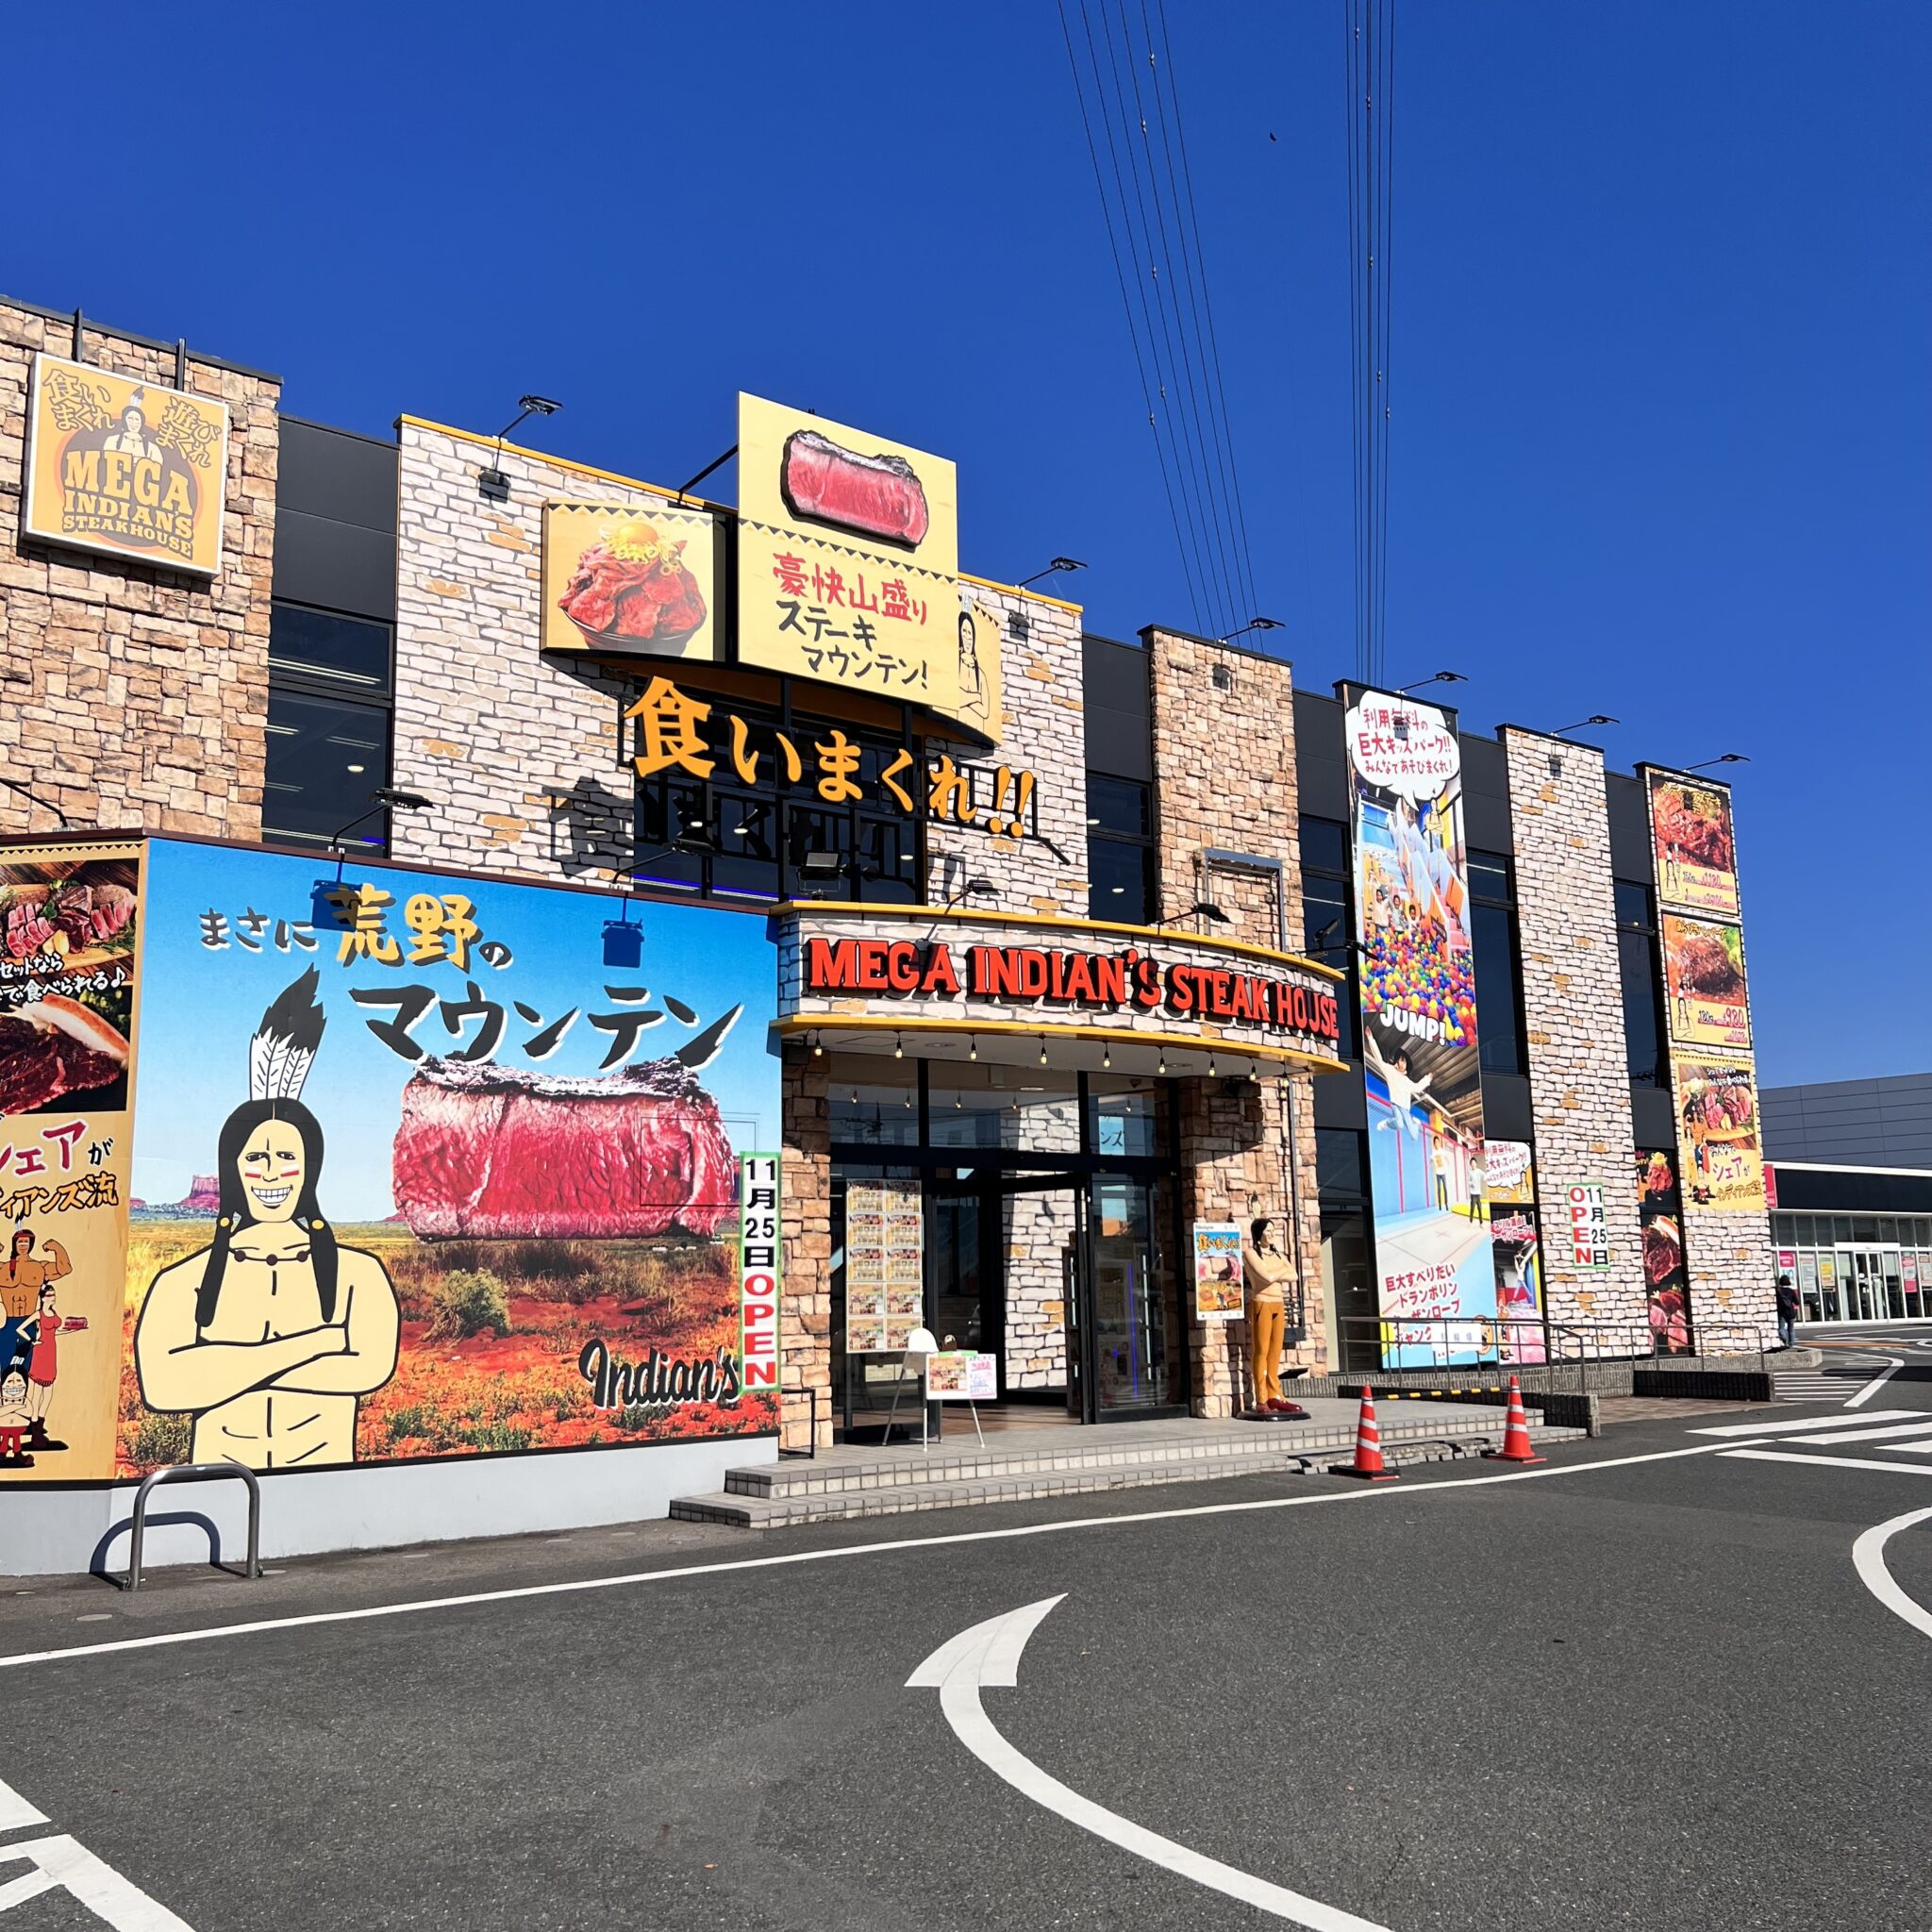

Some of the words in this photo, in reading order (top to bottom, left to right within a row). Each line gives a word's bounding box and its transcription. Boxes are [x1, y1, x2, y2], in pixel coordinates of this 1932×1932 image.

[42, 369, 111, 406] 食い
[52, 405, 115, 434] まくれ
[156, 421, 212, 468] まくれ
[162, 396, 222, 443] 遊び
[65, 450, 194, 516] MEGA
[63, 489, 194, 541] INDIAN'S
[772, 551, 927, 625] 豪快山盛り
[775, 600, 877, 651] ステーキ
[800, 645, 929, 691] マウンテン!
[624, 675, 1036, 839] 食いまくれ!!
[197, 883, 513, 971] まさに荒野の
[0, 952, 64, 978] セットなら
[808, 938, 960, 996] MEGA
[968, 946, 1163, 1009] INDIAN'S
[1169, 963, 1271, 1024] STEAK
[1273, 983, 1341, 1039] HOUSE
[347, 980, 745, 1073] マウンテン
[1379, 1002, 1447, 1047] JUMP!
[0, 1171, 119, 1219] ィアンズ流
[1569, 1187, 1592, 1265] OPEN
[1587, 1187, 1608, 1266] 11月25日
[1385, 1263, 1457, 1293] 巨大すべりだい
[579, 1337, 741, 1409] Indian's
